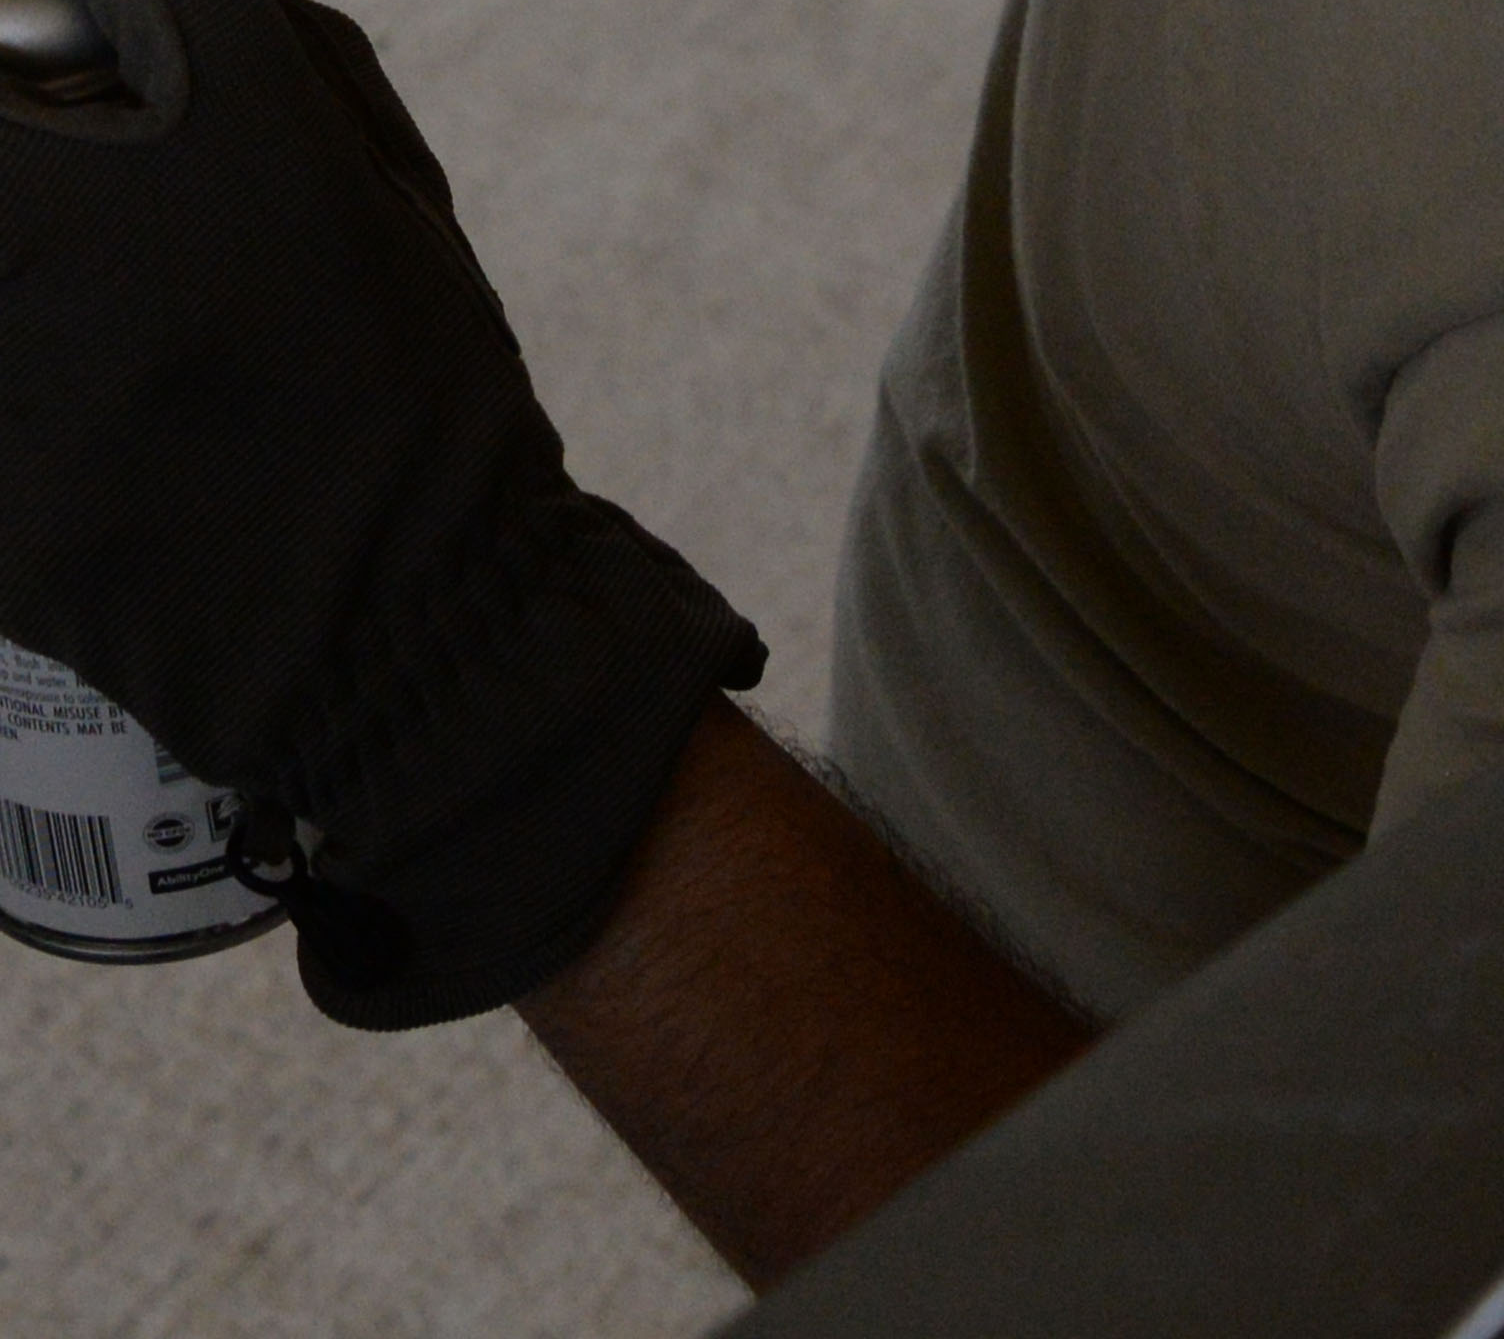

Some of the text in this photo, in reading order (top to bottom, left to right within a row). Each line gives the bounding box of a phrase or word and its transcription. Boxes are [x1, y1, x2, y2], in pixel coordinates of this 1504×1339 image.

[53, 705, 101, 721] MISUSE
[7, 713, 71, 735] CONTENTS
[77, 722, 104, 736] MAY
[111, 720, 128, 735] BE
